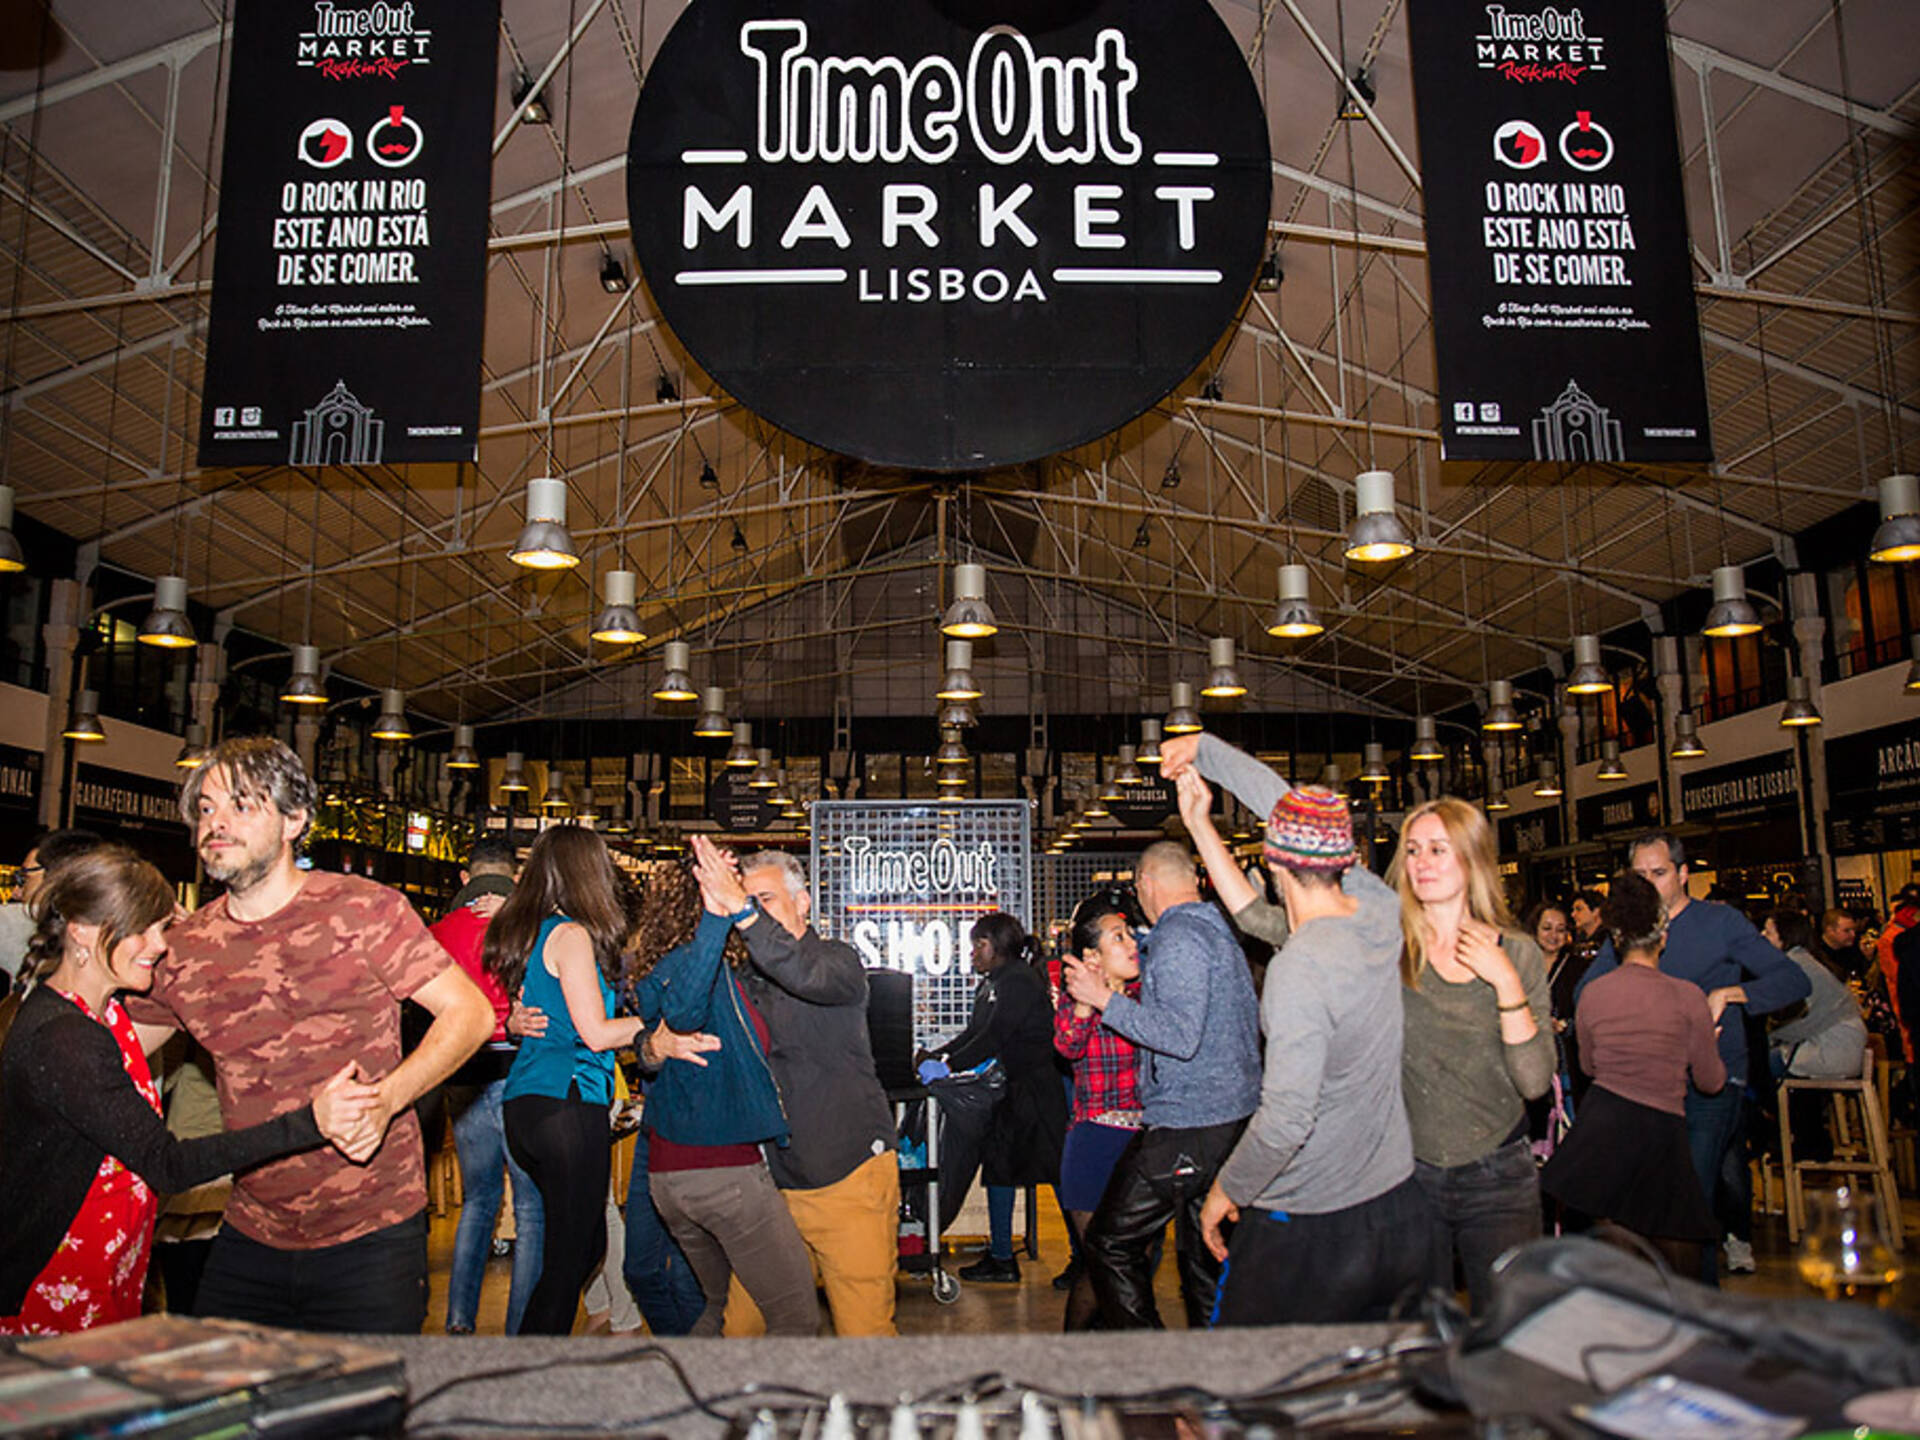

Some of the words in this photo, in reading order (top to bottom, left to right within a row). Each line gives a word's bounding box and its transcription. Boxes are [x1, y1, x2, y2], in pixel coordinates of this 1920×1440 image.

[315, 1, 370, 36] Time
[371, 1, 415, 36] Out
[1486, 4, 1542, 41] Time
[1542, 6, 1586, 42] Out
[298, 38, 430, 57] MARKET
[1477, 43, 1603, 61] MARKET
[315, 58, 361, 80] Rock
[374, 56, 409, 79] Rio
[1497, 61, 1543, 83] Rock
[1554, 62, 1587, 84] Rio
[740, 20, 962, 164] Time
[967, 24, 1143, 165] Out
[282, 181, 297, 213] O
[301, 180, 358, 212] ROCK
[362, 180, 385, 211] IN
[390, 178, 426, 210] RIO
[1486, 181, 1501, 213] O
[1504, 182, 1560, 214] ROCK
[1563, 183, 1587, 213] IN
[1590, 184, 1625, 214] RIO
[273, 217, 325, 249] ESTE
[327, 216, 373, 248] ANO
[377, 209, 430, 247] ESTÁ
[683, 184, 1215, 250] MARKET
[1483, 217, 1534, 248] ESTE
[1537, 218, 1580, 249] ANO
[1584, 214, 1636, 250] ESTÁ
[277, 254, 306, 286] DE
[309, 253, 337, 285] SE
[340, 251, 420, 284] COMER.
[859, 268, 1047, 302] LISBOA
[1493, 253, 1522, 284] DE
[1525, 253, 1551, 284] SE
[1554, 254, 1632, 286] COMER.
[844, 837, 930, 893] Time
[930, 838, 998, 894] Out
